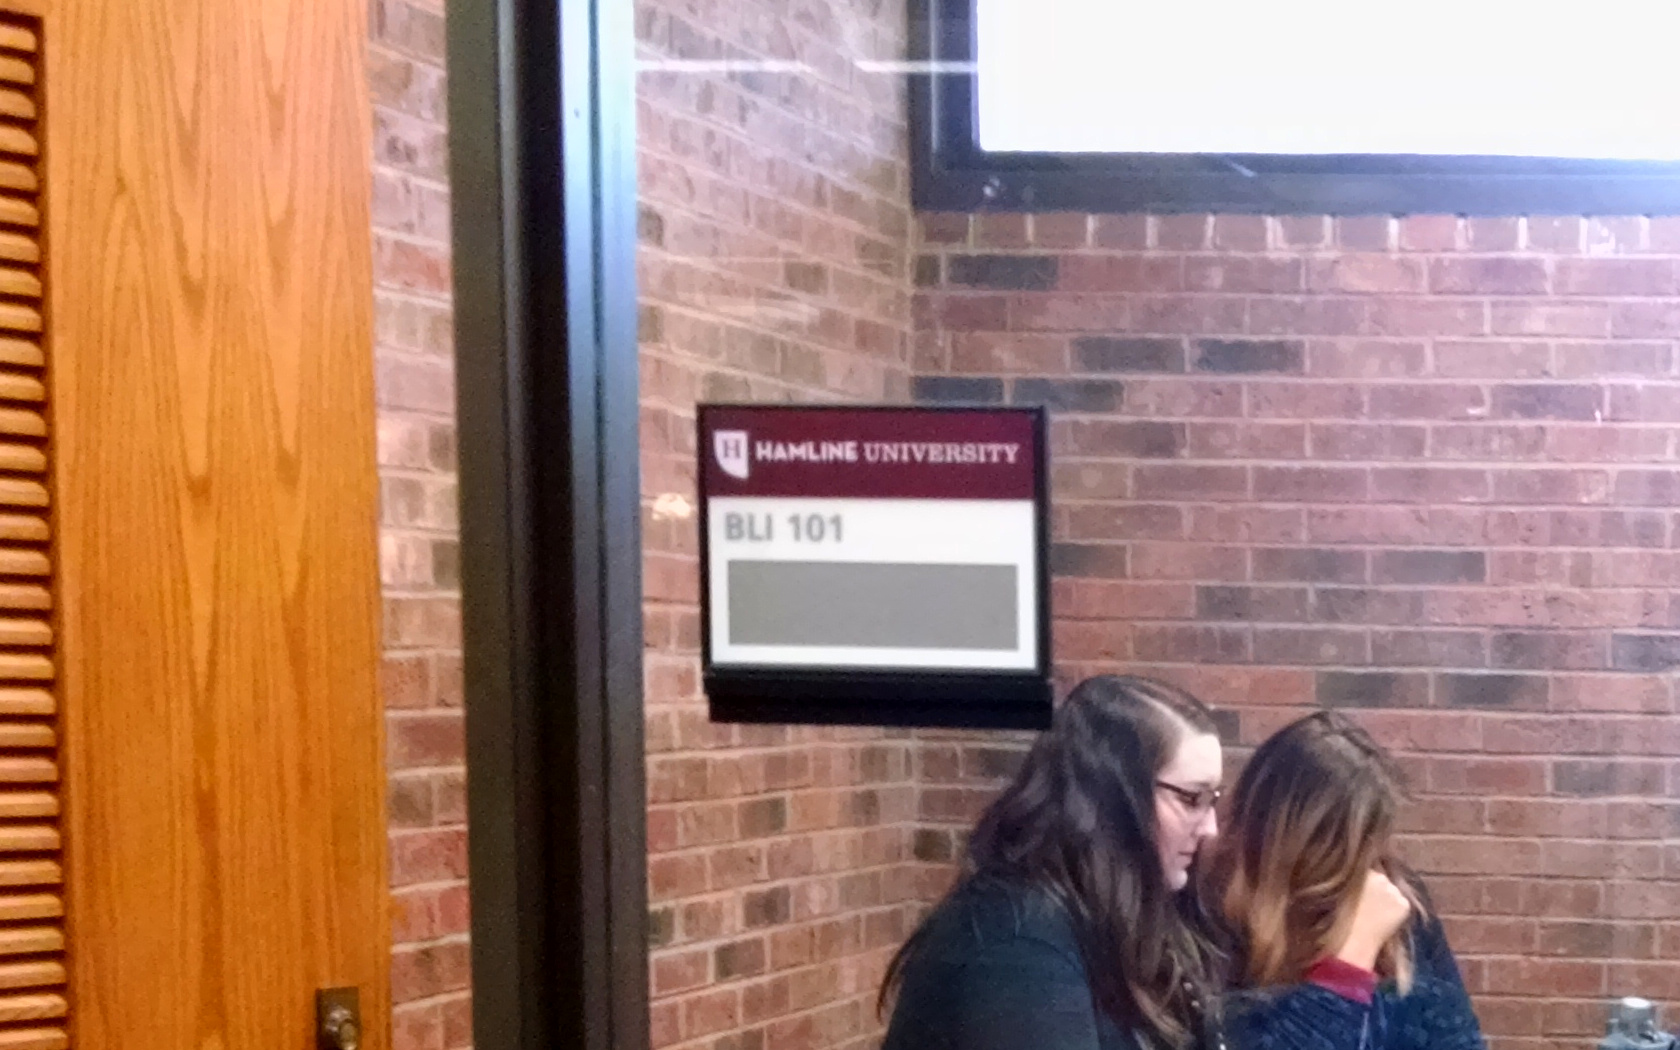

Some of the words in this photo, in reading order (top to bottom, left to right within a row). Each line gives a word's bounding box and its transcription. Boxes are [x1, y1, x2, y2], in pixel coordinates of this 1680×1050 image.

[754, 440, 859, 464] HAMLINE
[863, 442, 1021, 465] UNIVERSITY
[724, 512, 774, 542] BLI
[788, 513, 846, 543] 101
